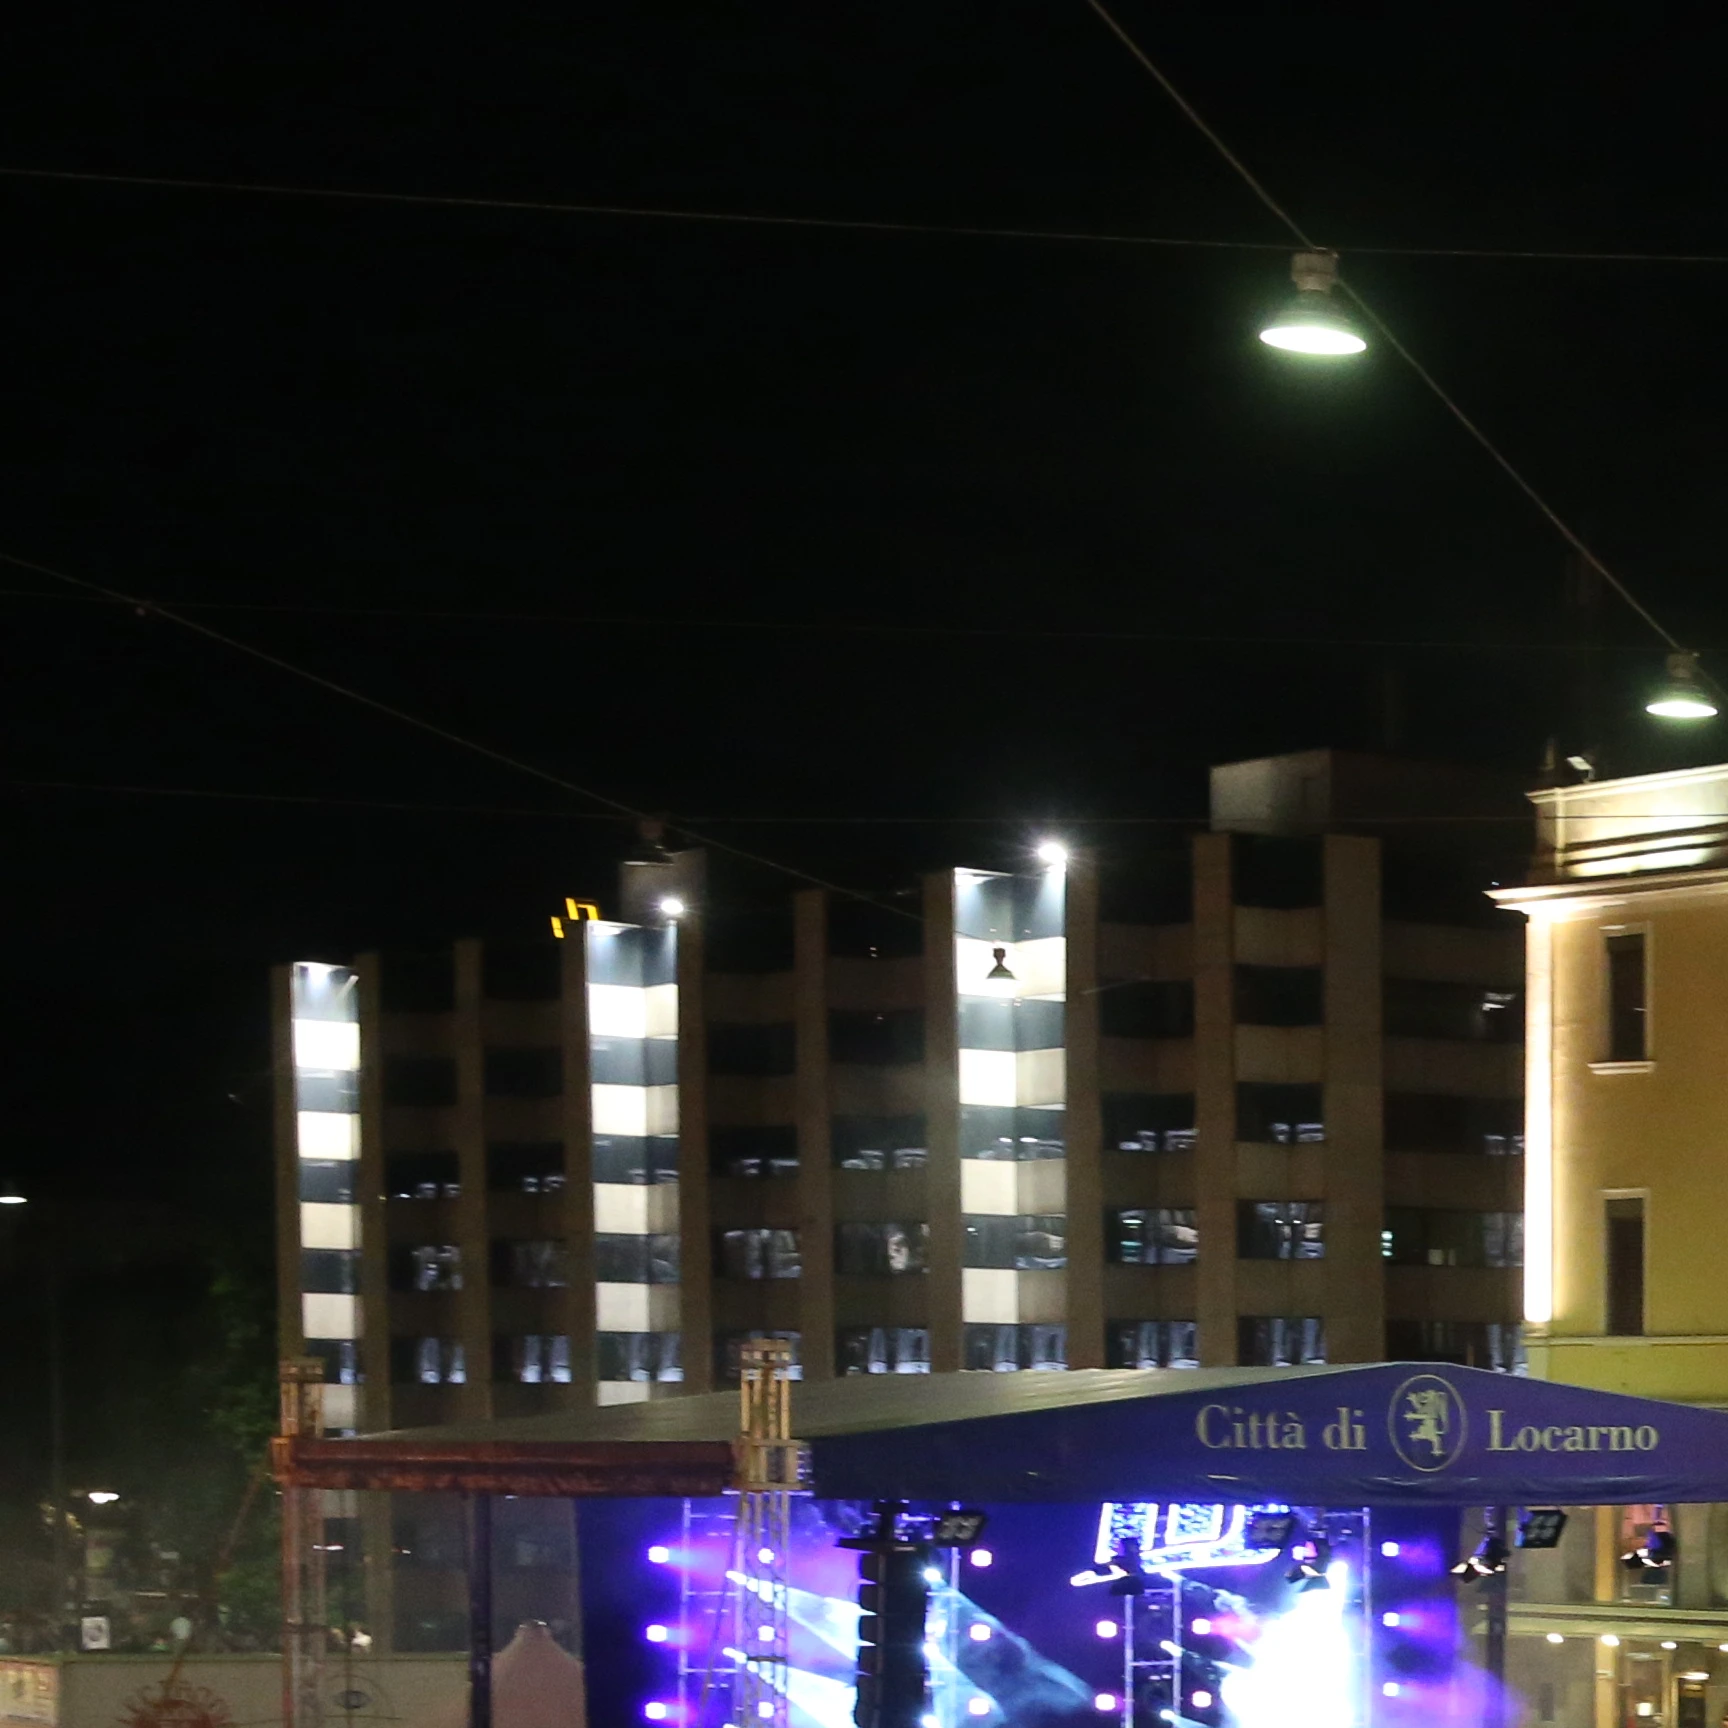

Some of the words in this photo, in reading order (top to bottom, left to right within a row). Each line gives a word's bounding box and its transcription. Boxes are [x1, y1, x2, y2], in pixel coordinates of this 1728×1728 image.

[1194, 1403, 1306, 1450] Città
[1322, 1406, 1367, 1451] di
[1485, 1410, 1659, 1453] Locarno
